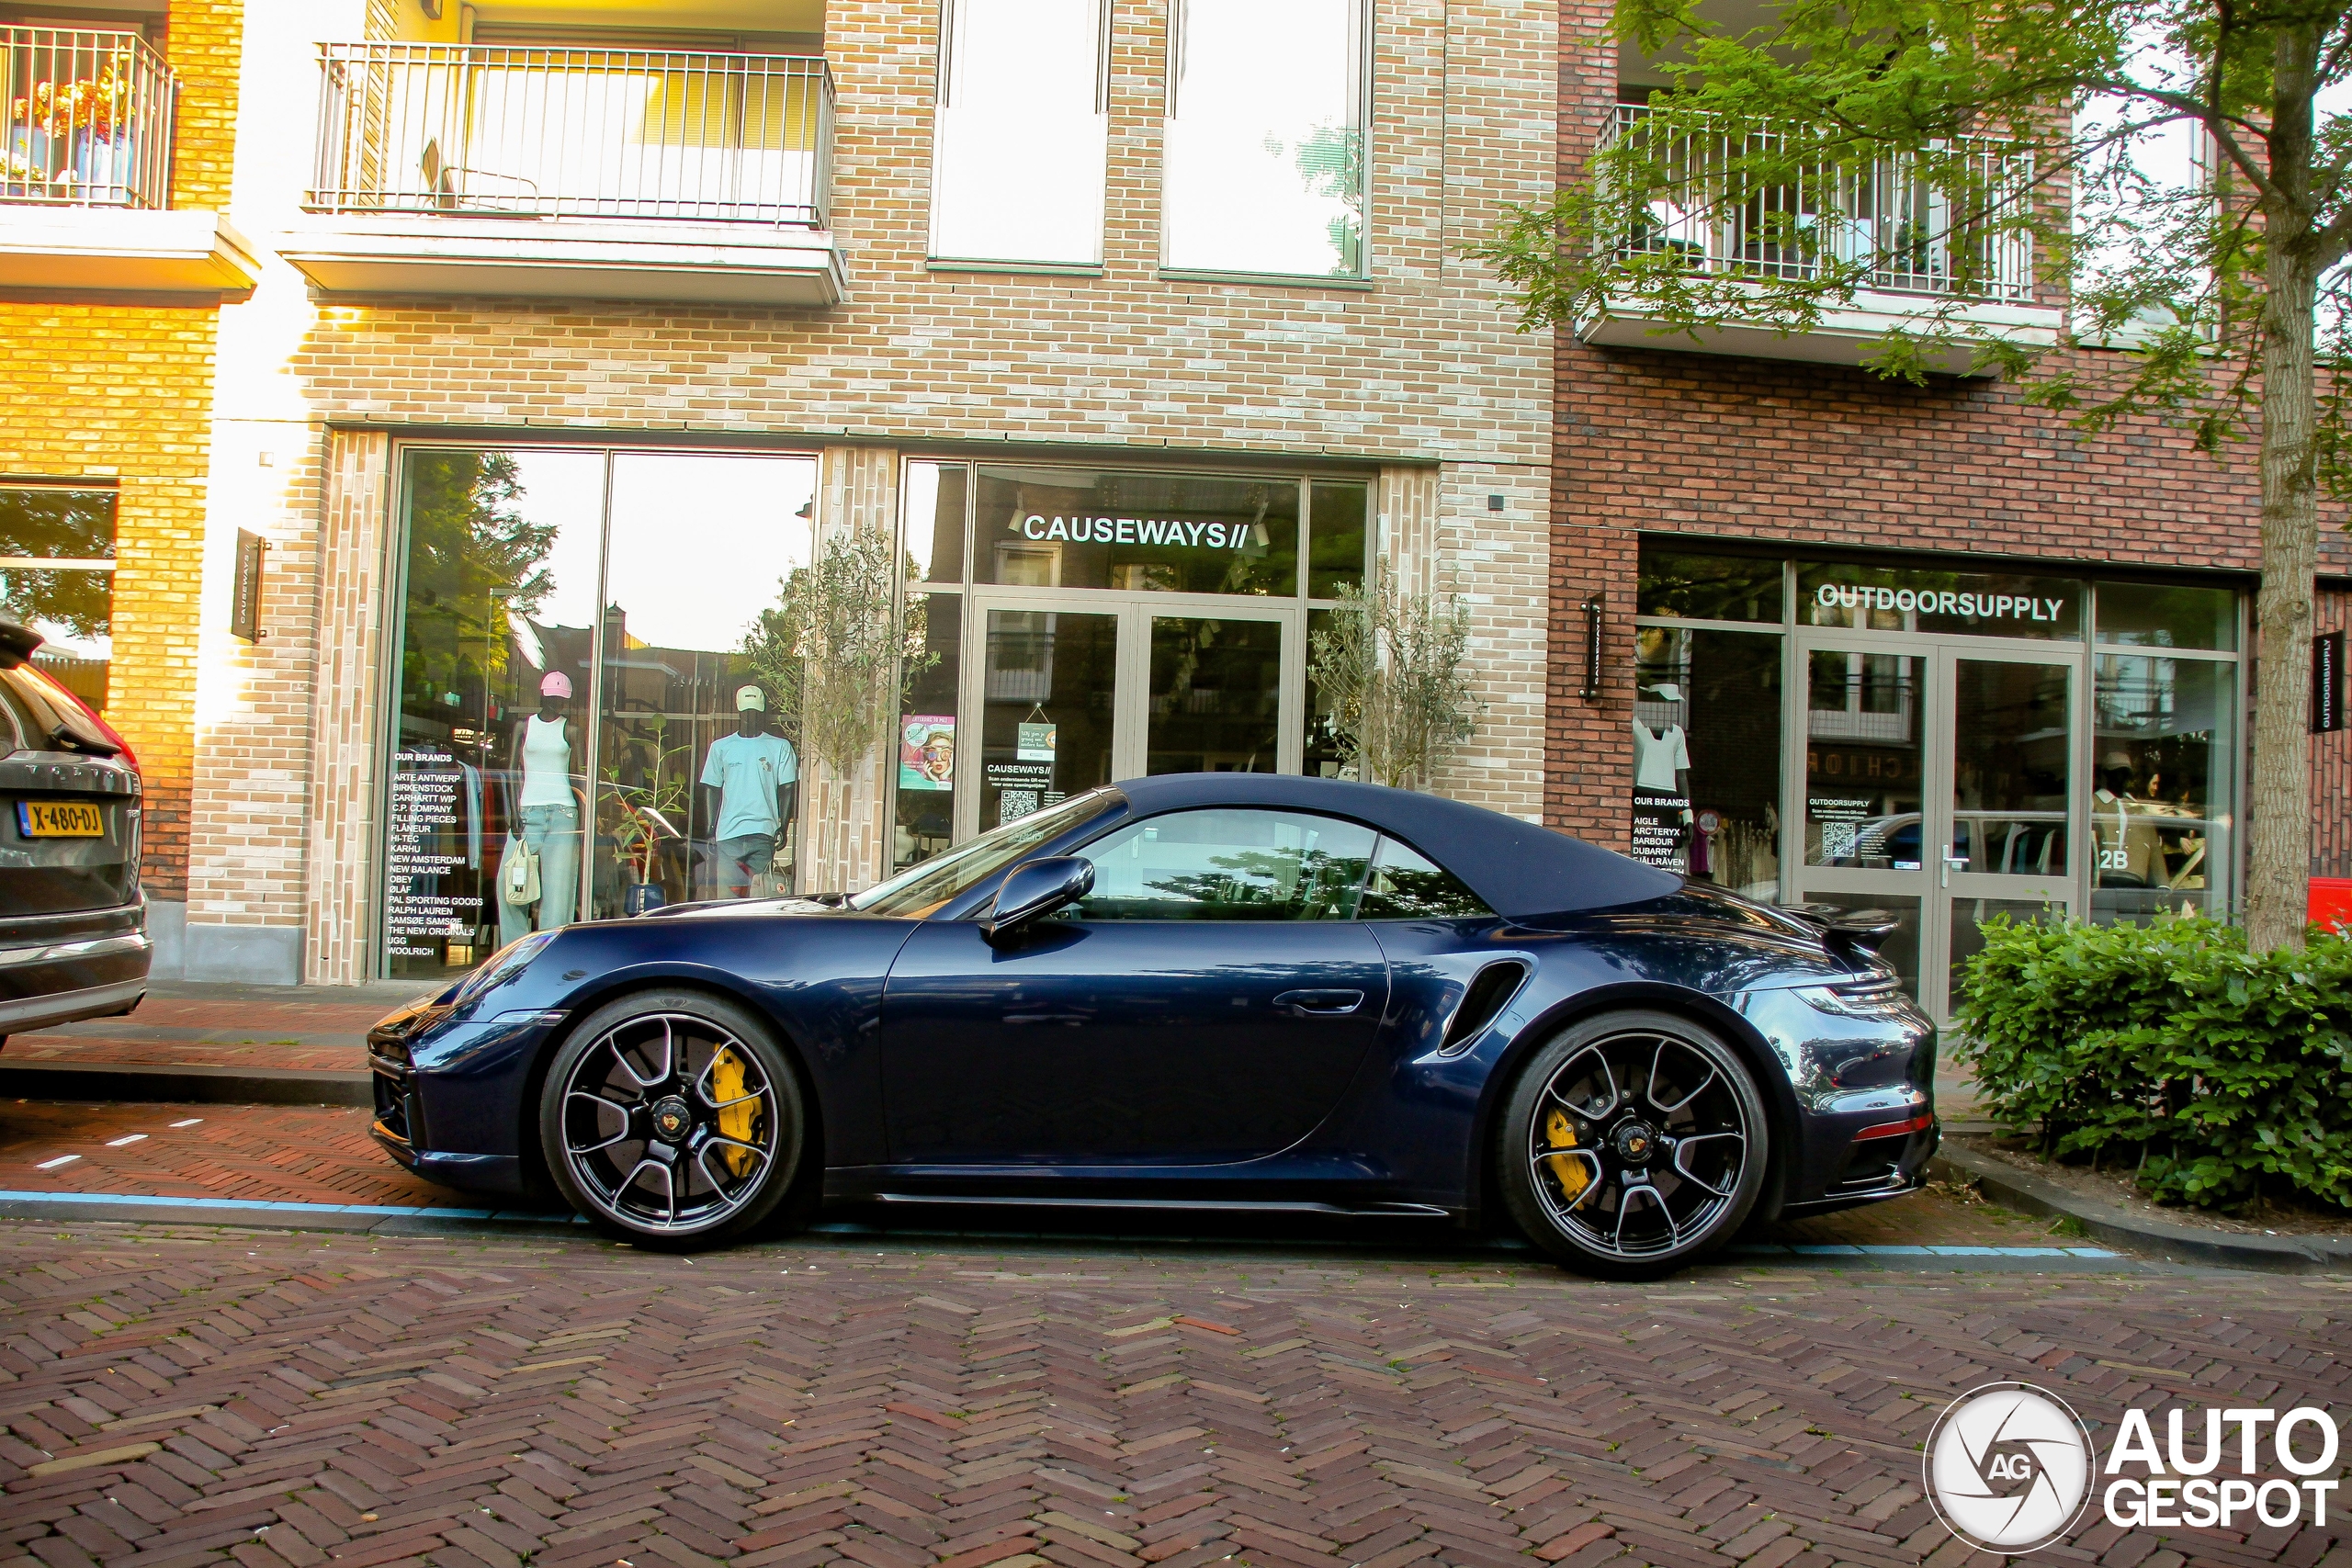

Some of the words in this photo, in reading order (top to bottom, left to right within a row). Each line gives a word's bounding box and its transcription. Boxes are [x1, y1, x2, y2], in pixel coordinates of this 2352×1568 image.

[241, 554, 250, 624] CAUSEWAYS
[1817, 583, 2064, 621] OUTDOORSUPPLY
[2323, 639, 2331, 728] OUTDOORSUPPLY
[415, 753, 452, 762] BRANDS
[394, 773, 416, 782] ARTE
[418, 774, 460, 783] ANTWERP
[393, 784, 453, 793] BIRKENSTOCK
[1634, 797, 1653, 806] OUR
[1655, 798, 1690, 807] BRANDS
[1809, 798, 1870, 807] OUTDOORSUPPLY
[410, 805, 452, 813] COMPANY
[33, 807, 98, 830] X-480-DJ
[425, 815, 457, 823] PIECES
[1634, 828, 1680, 836] ARC'TERYX
[1633, 837, 1673, 845] BARBOUR
[1633, 847, 1672, 855] DUBARRY
[412, 855, 465, 864] AMSTERDAM
[2099, 850, 2128, 869] 2B
[412, 866, 451, 874] BALANCE
[390, 875, 413, 884] OBEY
[406, 897, 449, 905] SPORTING
[451, 897, 483, 906] GOODS
[407, 927, 427, 935] NEW
[429, 928, 475, 936] ORIGINALS
[388, 947, 434, 955] WOOLRICH
